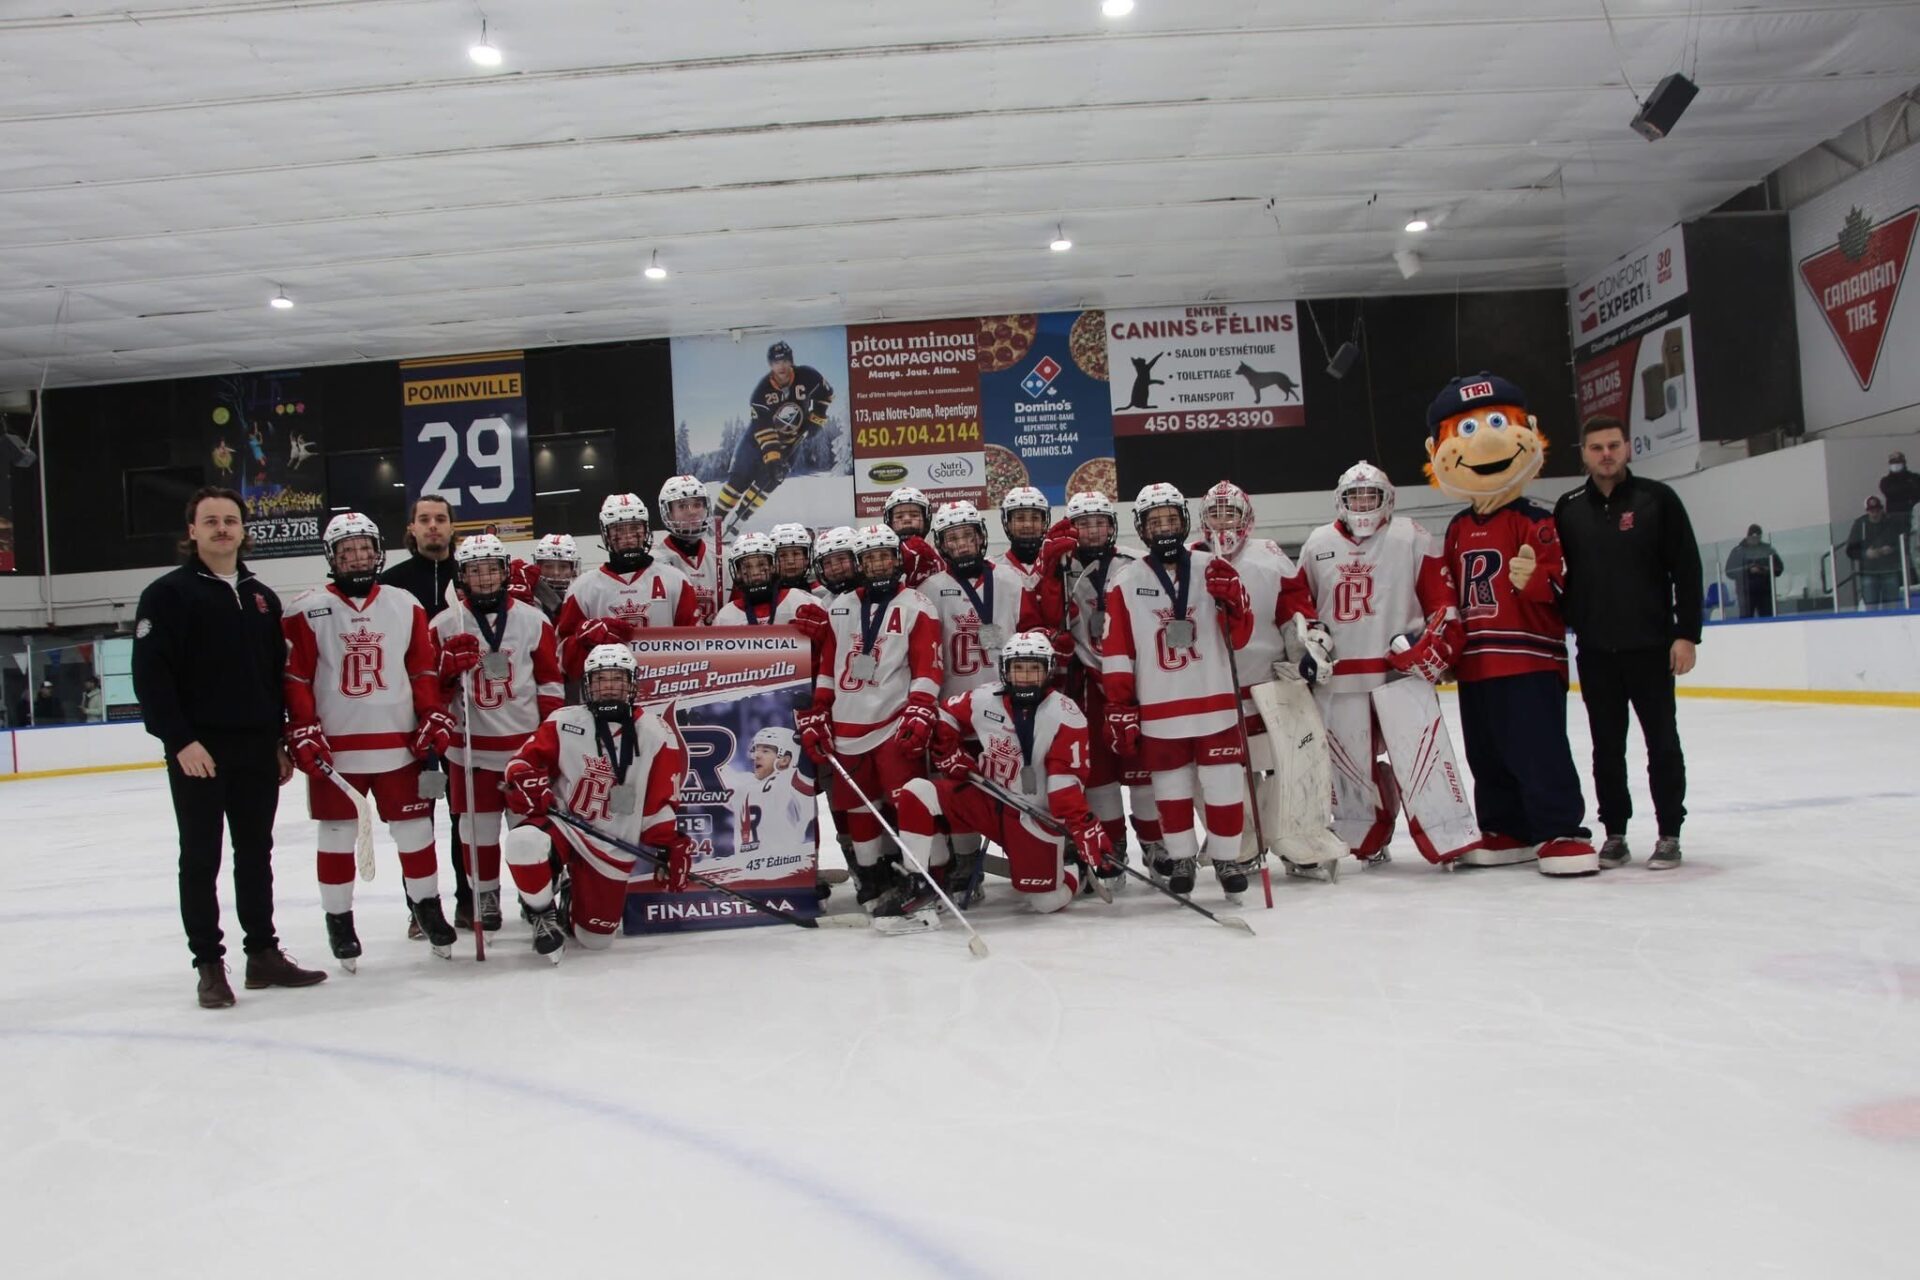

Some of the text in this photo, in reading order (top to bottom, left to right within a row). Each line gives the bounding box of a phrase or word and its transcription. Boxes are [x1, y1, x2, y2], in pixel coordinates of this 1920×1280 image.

[1657, 248, 1671, 270] 30
[1597, 254, 1648, 300] CONFORT
[1824, 260, 1897, 311] CANADIAN
[1185, 306, 1227, 318] ENTRE
[1599, 282, 1644, 324] EXPERT
[1845, 300, 1878, 333] TIRE
[1111, 312, 1294, 340] CANINS & FÉLINS
[850, 331, 976, 356] pitou minou
[1175, 343, 1276, 359] SALON D'ESTHÉTIQUE
[851, 349, 976, 368] & COMPAGNONS
[868, 370, 903, 380] Mange.
[1177, 369, 1232, 381] TOILETTAGE
[408, 378, 519, 401] POMINVILLE
[765, 384, 806, 405] 29 C
[914, 387, 928, 396] dans
[929, 387, 934, 395] la
[1462, 383, 1491, 399] TIRI
[1582, 382, 1594, 402] 36
[1595, 370, 1621, 397] MOIS
[1014, 399, 1072, 413] Domino's
[1178, 392, 1235, 404] TRANSPORT
[855, 402, 978, 423] 173, rue Notre-Dame, Repentigny
[1144, 410, 1274, 432] 450 582-3390
[857, 422, 979, 448] 450.704.2144
[1014, 432, 1079, 447] (450) 721-4444
[1021, 445, 1073, 458] DOMINOS.CA
[417, 417, 515, 506] 29
[941, 461, 962, 470] Nutri
[934, 468, 967, 478] Source
[945, 489, 981, 499] NutriSource
[652, 576, 667, 600] A
[886, 606, 903, 634] A
[631, 639, 798, 652] TOURNOI PROVINCIAL
[637, 660, 709, 681] Classique
[651, 661, 796, 696] Jason Pominville
[430, 712, 456, 730] CC
[1108, 712, 1139, 723] CC
[293, 724, 322, 739] CM
[523, 775, 549, 788] CC
[1444, 761, 1463, 804] BAUER
[680, 790, 731, 802] NTIGNY
[690, 838, 713, 856] 24
[766, 855, 801, 868] Edition
[647, 901, 758, 921] FINALISTE
